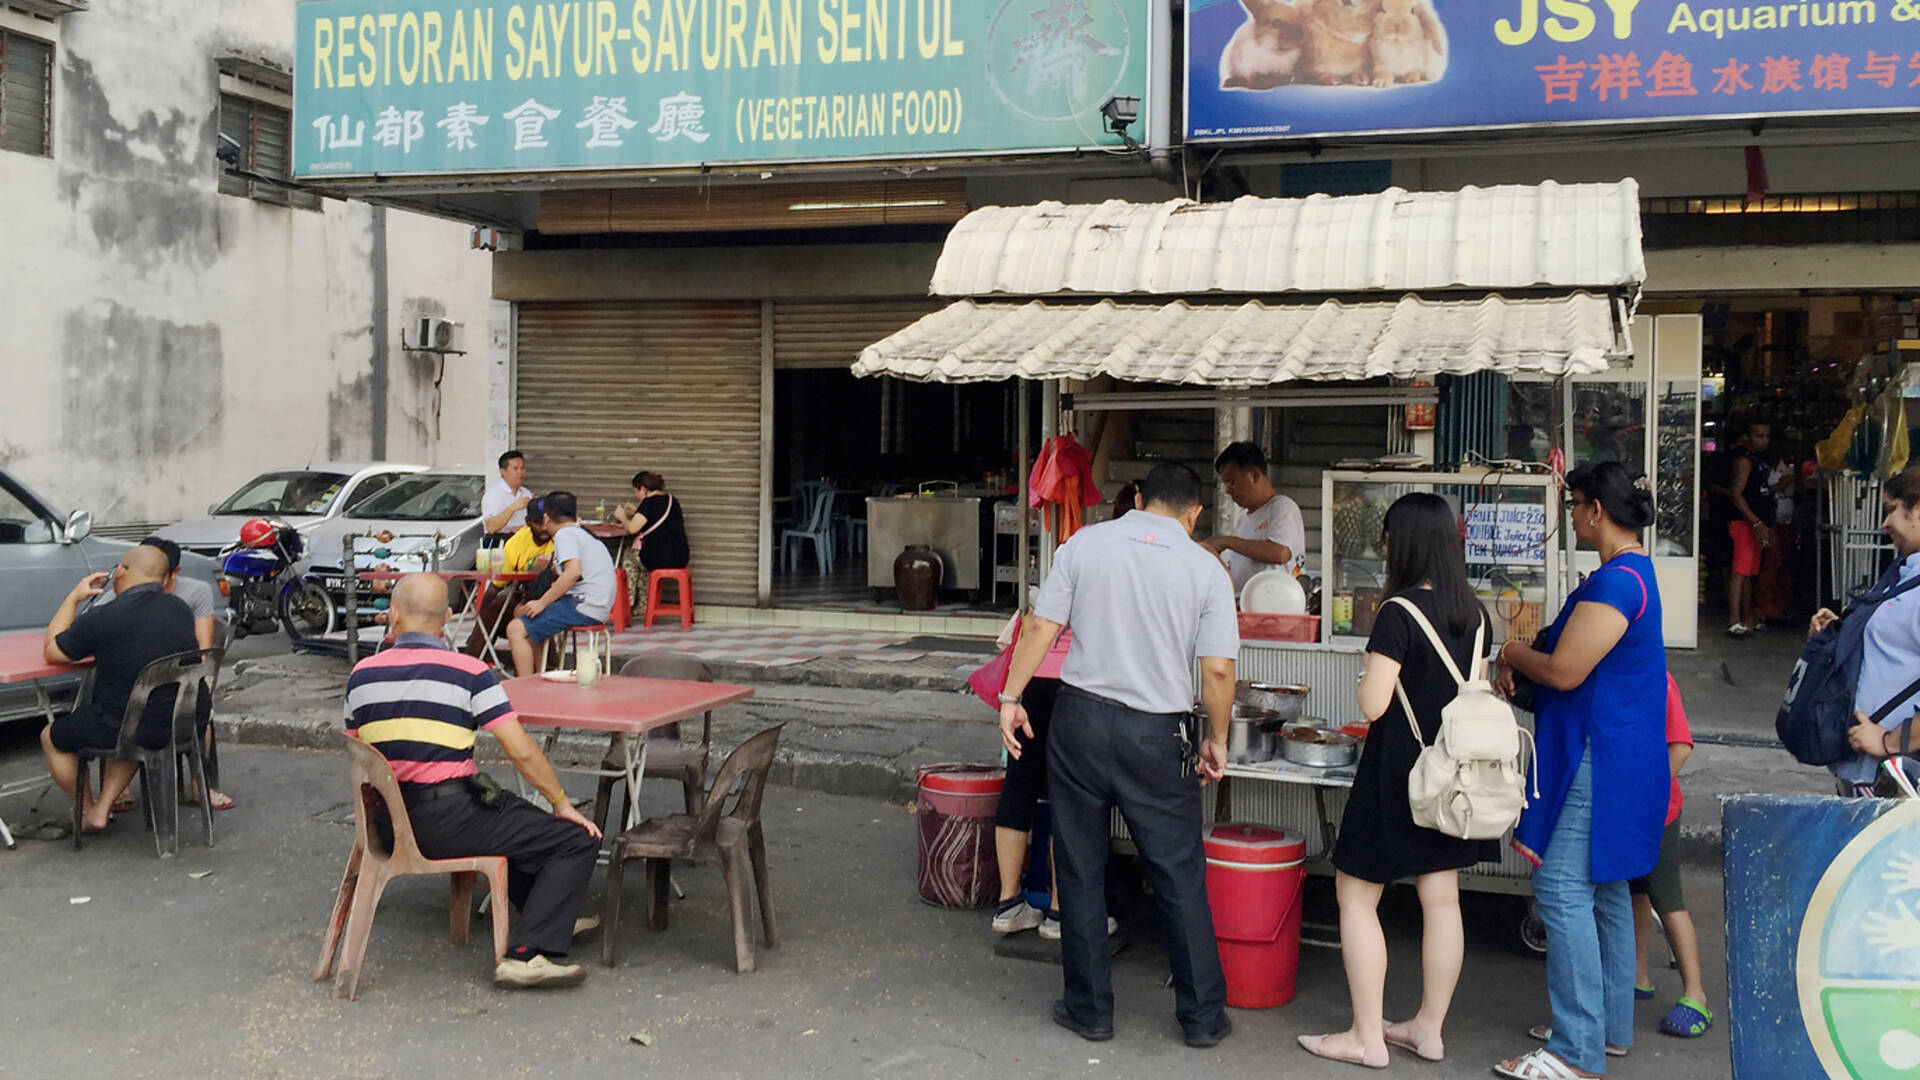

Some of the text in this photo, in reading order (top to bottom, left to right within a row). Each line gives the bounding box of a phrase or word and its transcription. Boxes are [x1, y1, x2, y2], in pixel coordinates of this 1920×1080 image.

[313, 0, 964, 89] RESTORAN SAYUR-SAYURAN SENTUL
[1494, 0, 1641, 46] JSY
[1666, 0, 1876, 40] Aquarium
[1534, 49, 1698, 104] 吉祥鱼
[312, 91, 711, 154] 仙都素食餐廳
[735, 87, 963, 143] (VEGETARIAN FOOD)
